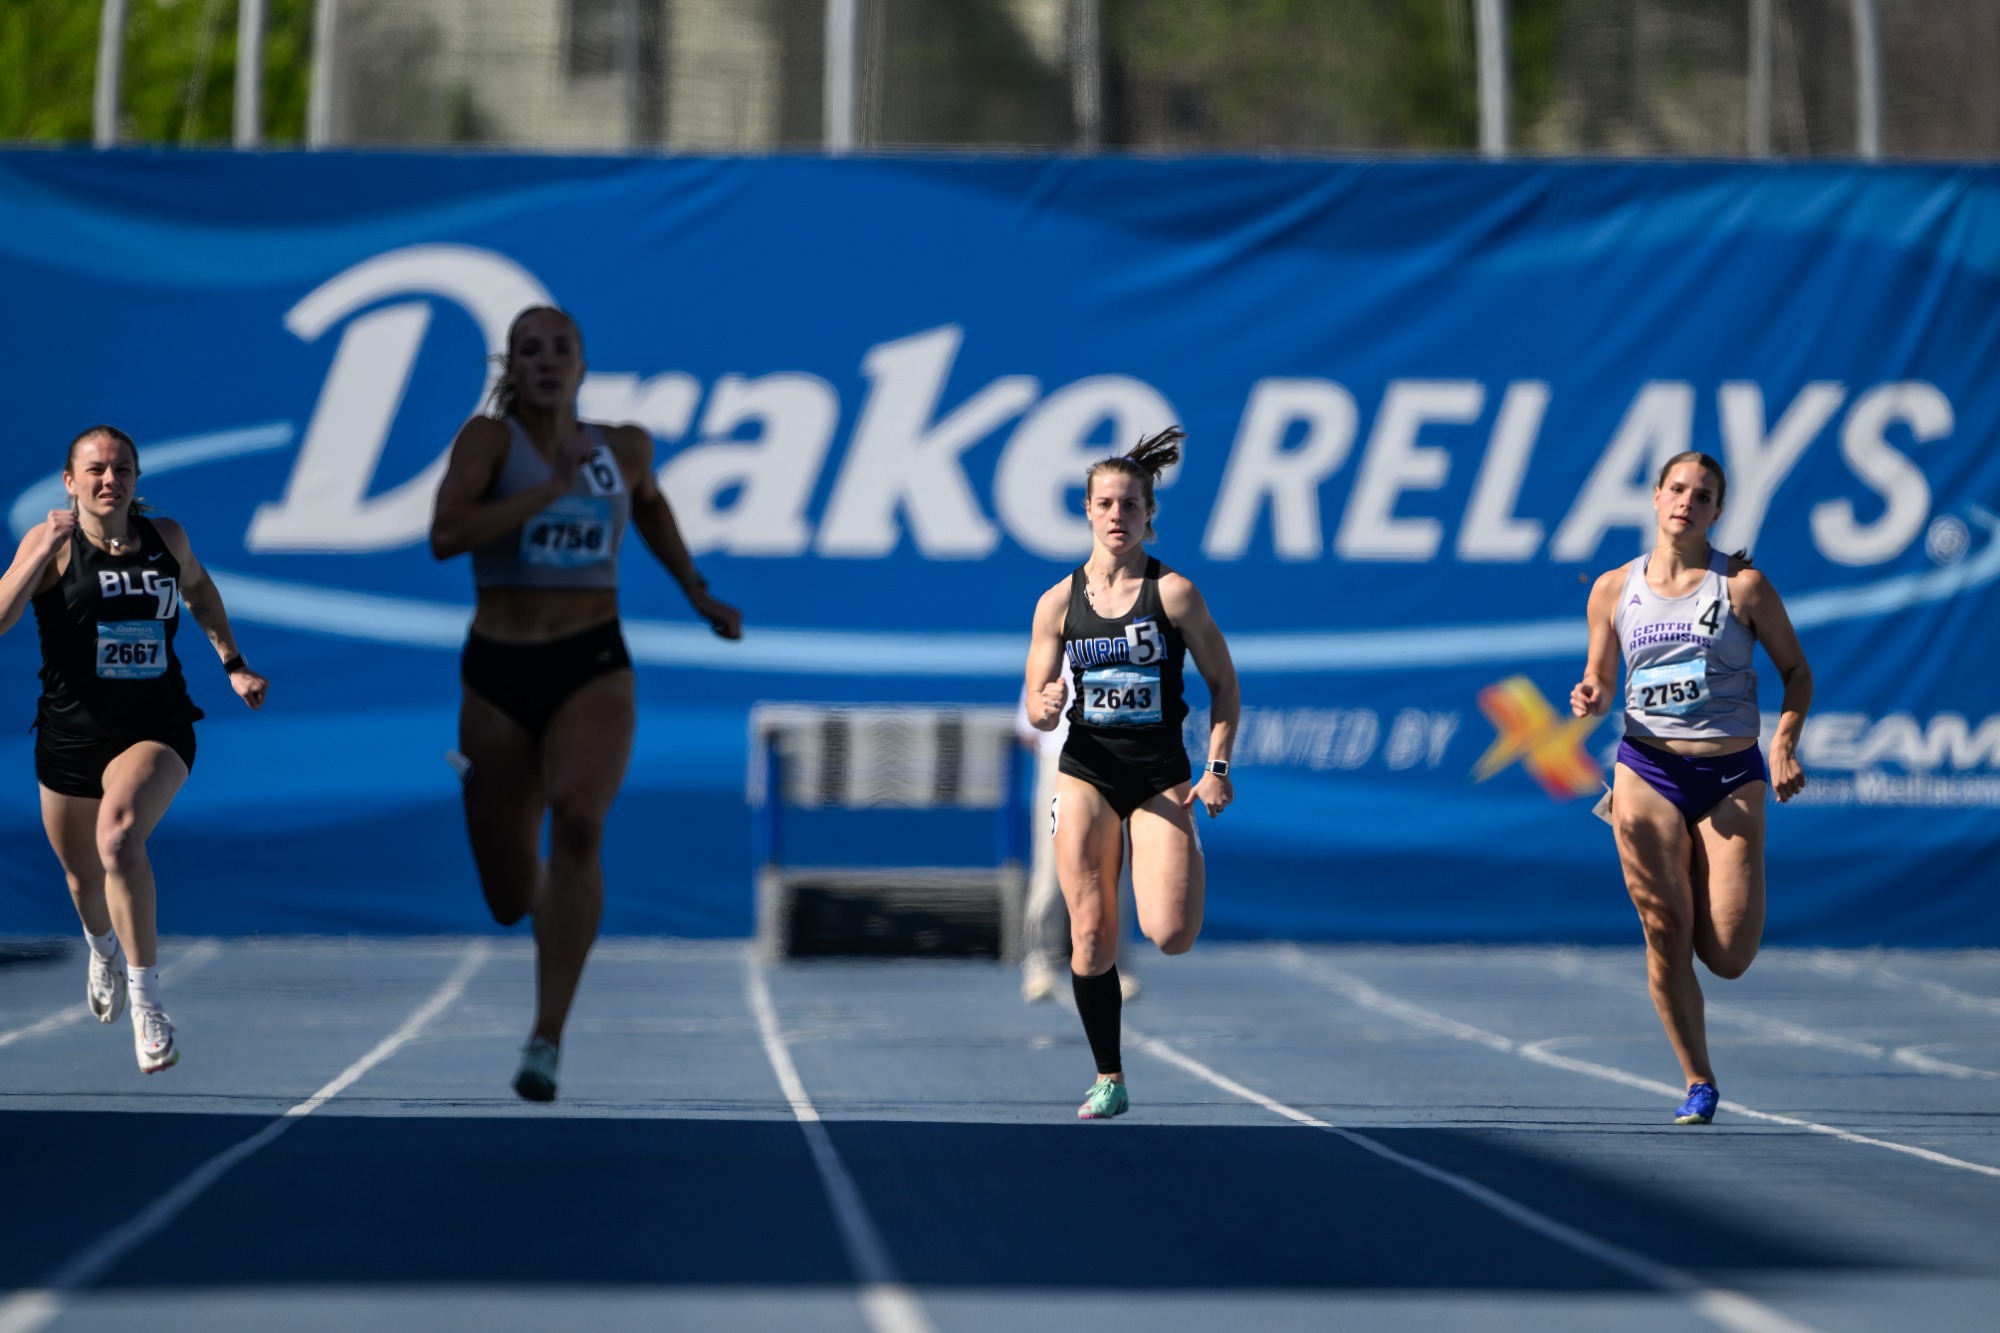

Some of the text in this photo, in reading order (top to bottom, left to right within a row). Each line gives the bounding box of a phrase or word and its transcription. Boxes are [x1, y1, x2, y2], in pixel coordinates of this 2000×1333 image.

[247, 244, 1954, 566] Drake RELAYS
[588, 448, 614, 491] 6
[530, 523, 605, 550] 4756
[1633, 622, 1693, 639] CENTR
[1698, 600, 1720, 636] 4
[104, 643, 159, 665] 2667
[1066, 634, 1168, 668] AUROA
[1134, 624, 1156, 663] 5
[1629, 633, 1712, 652] ARKANSAS
[1092, 687, 1152, 709] 2643
[1641, 679, 1701, 707] 2753
[1385, 706, 1460, 771] BY
